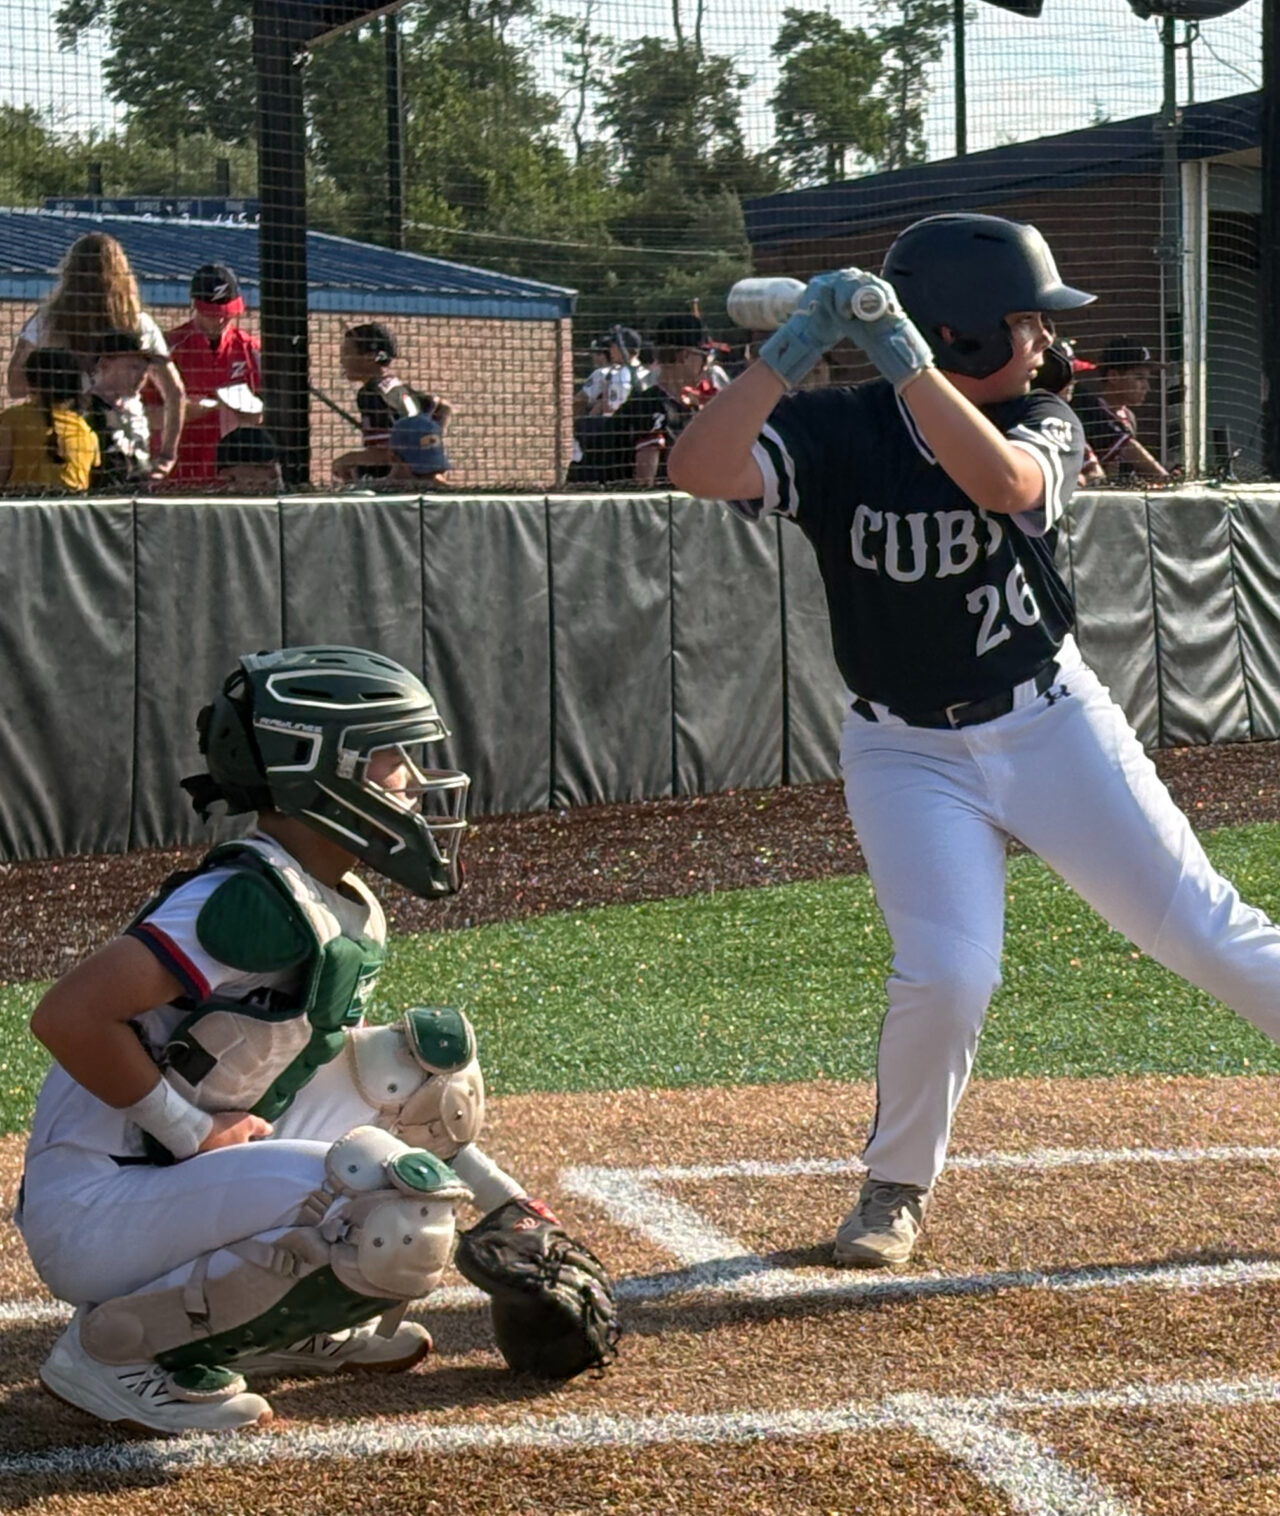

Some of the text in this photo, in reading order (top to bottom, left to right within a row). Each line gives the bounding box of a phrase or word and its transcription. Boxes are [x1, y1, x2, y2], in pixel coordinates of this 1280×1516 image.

[211, 283, 229, 301] Z
[231, 361, 247, 379] Z
[965, 557, 1041, 657] 26
